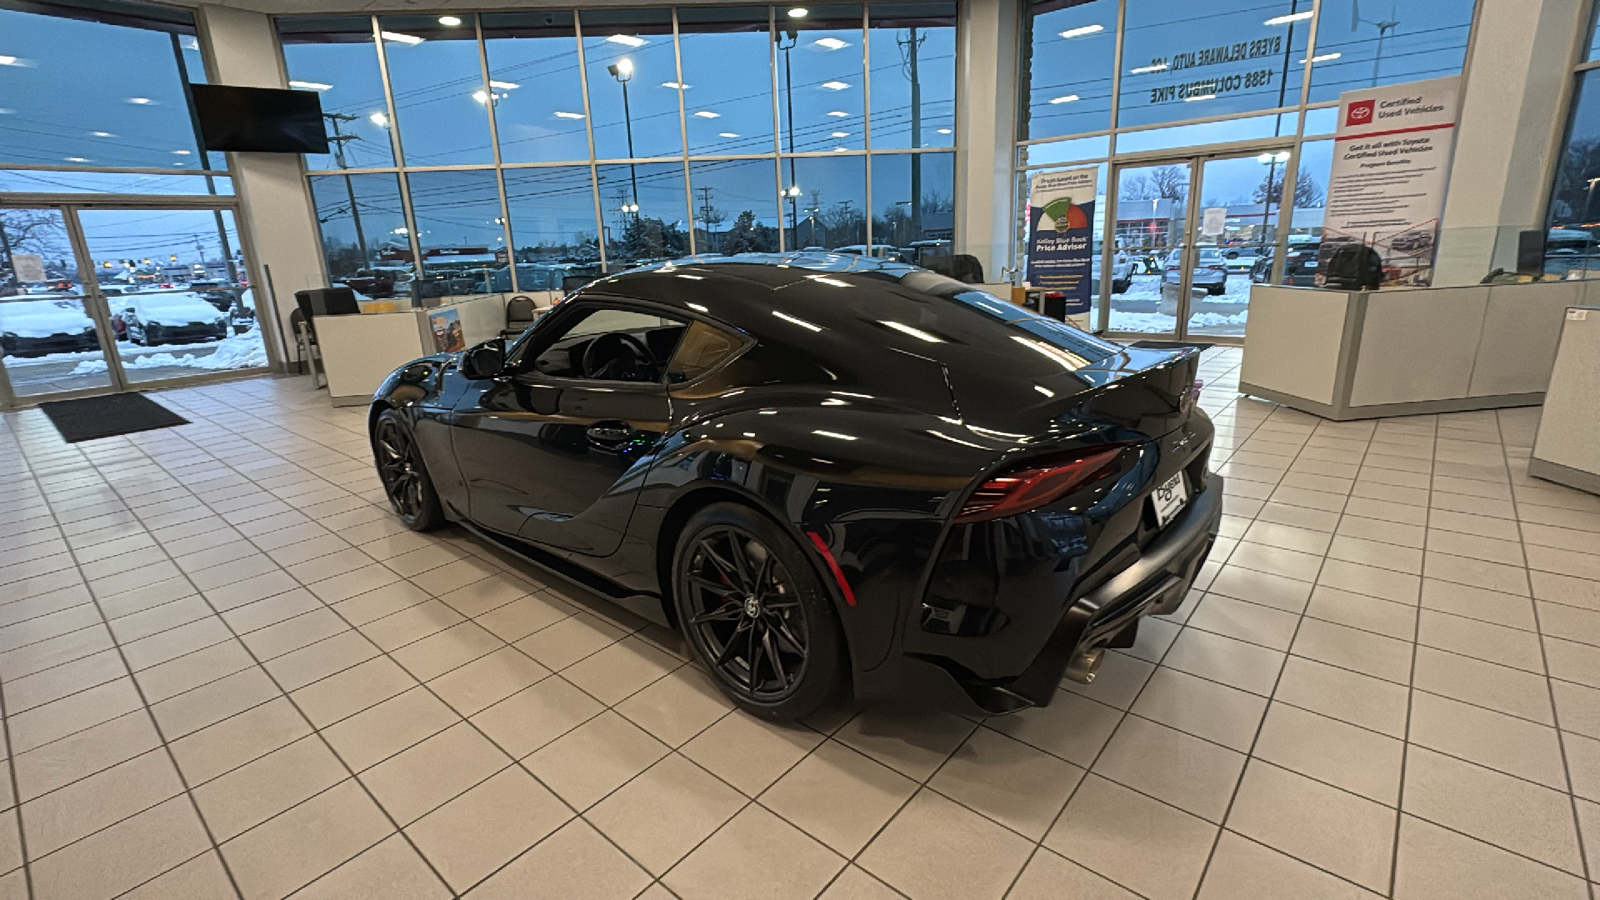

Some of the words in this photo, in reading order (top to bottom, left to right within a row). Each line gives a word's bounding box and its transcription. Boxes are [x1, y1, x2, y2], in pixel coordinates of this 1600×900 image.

[1380, 96, 1422, 109] Certified
[1378, 109, 1402, 119] Used
[1404, 105, 1444, 115] Vehicles
[1343, 150, 1377, 160] Certified
[1399, 145, 1433, 154] Vehicles
[1036, 238, 1055, 246] Kelley
[1036, 244, 1056, 252] Price
[1056, 243, 1087, 251] Advisor
